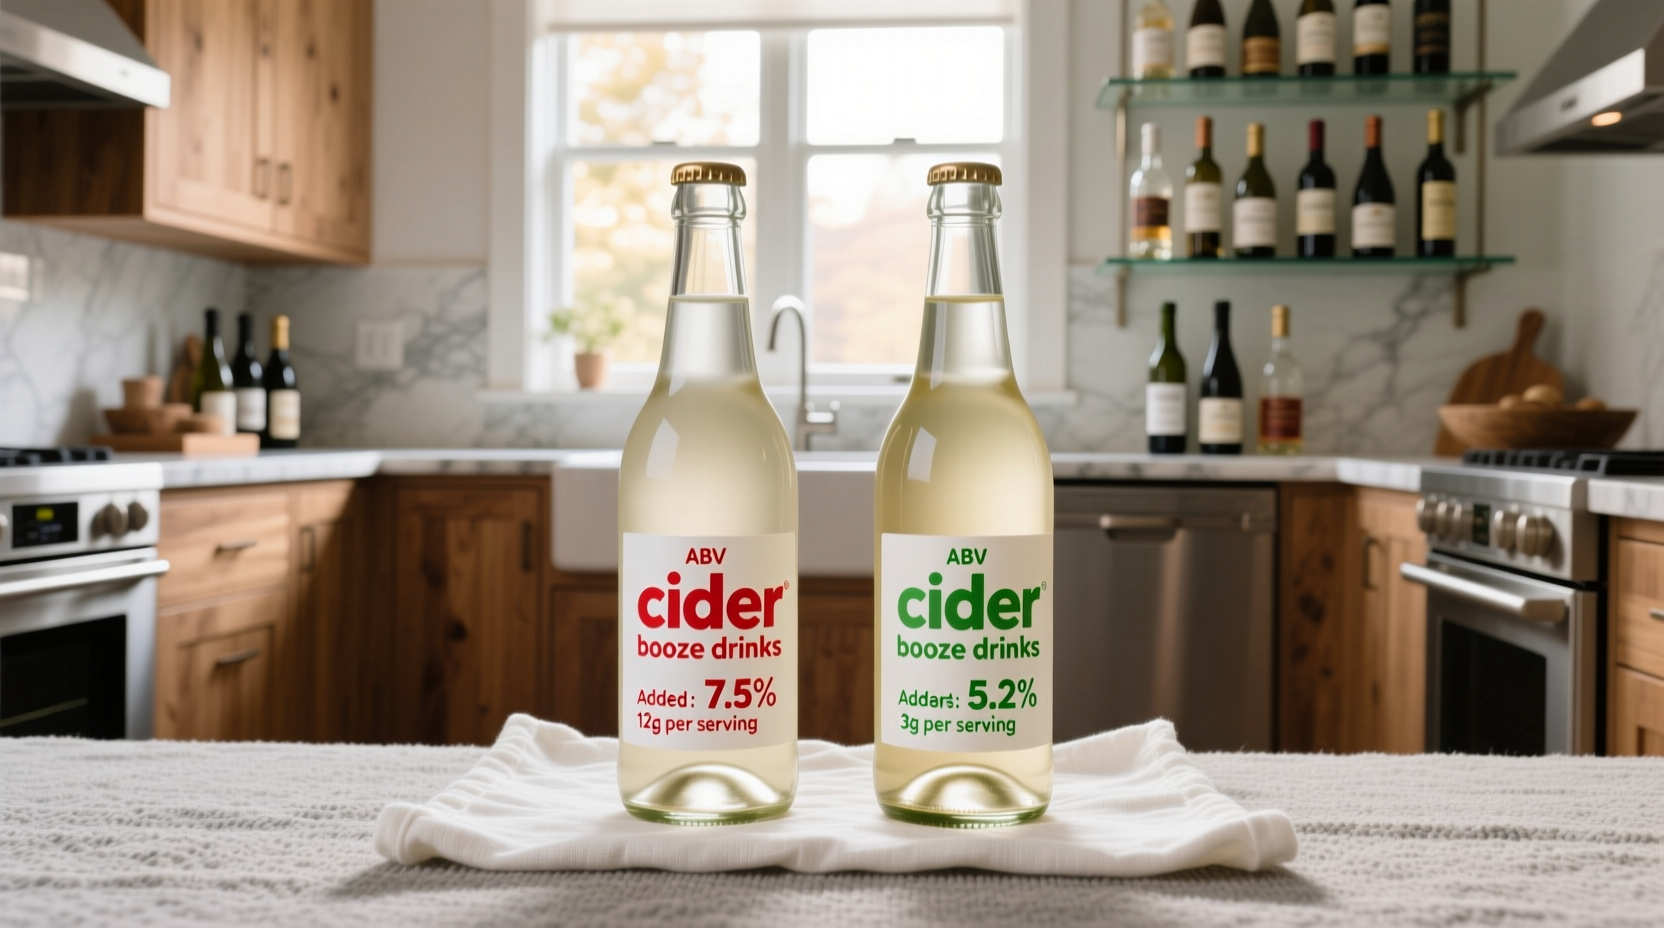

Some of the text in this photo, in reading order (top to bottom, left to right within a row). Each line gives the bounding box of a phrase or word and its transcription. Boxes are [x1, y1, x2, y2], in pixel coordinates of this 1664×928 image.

[685, 547, 727, 565] ABV
[946, 548, 988, 565] ABV
[637, 571, 784, 630] cider
[897, 571, 1041, 630] cider
[637, 634, 782, 660] booze drinks
[897, 634, 1040, 660] booze drinks
[705, 676, 777, 709] 7.5%
[967, 677, 1037, 710] 5.2%
[637, 711, 758, 735] 12g per serving
[900, 713, 1016, 736] 3g per serving
